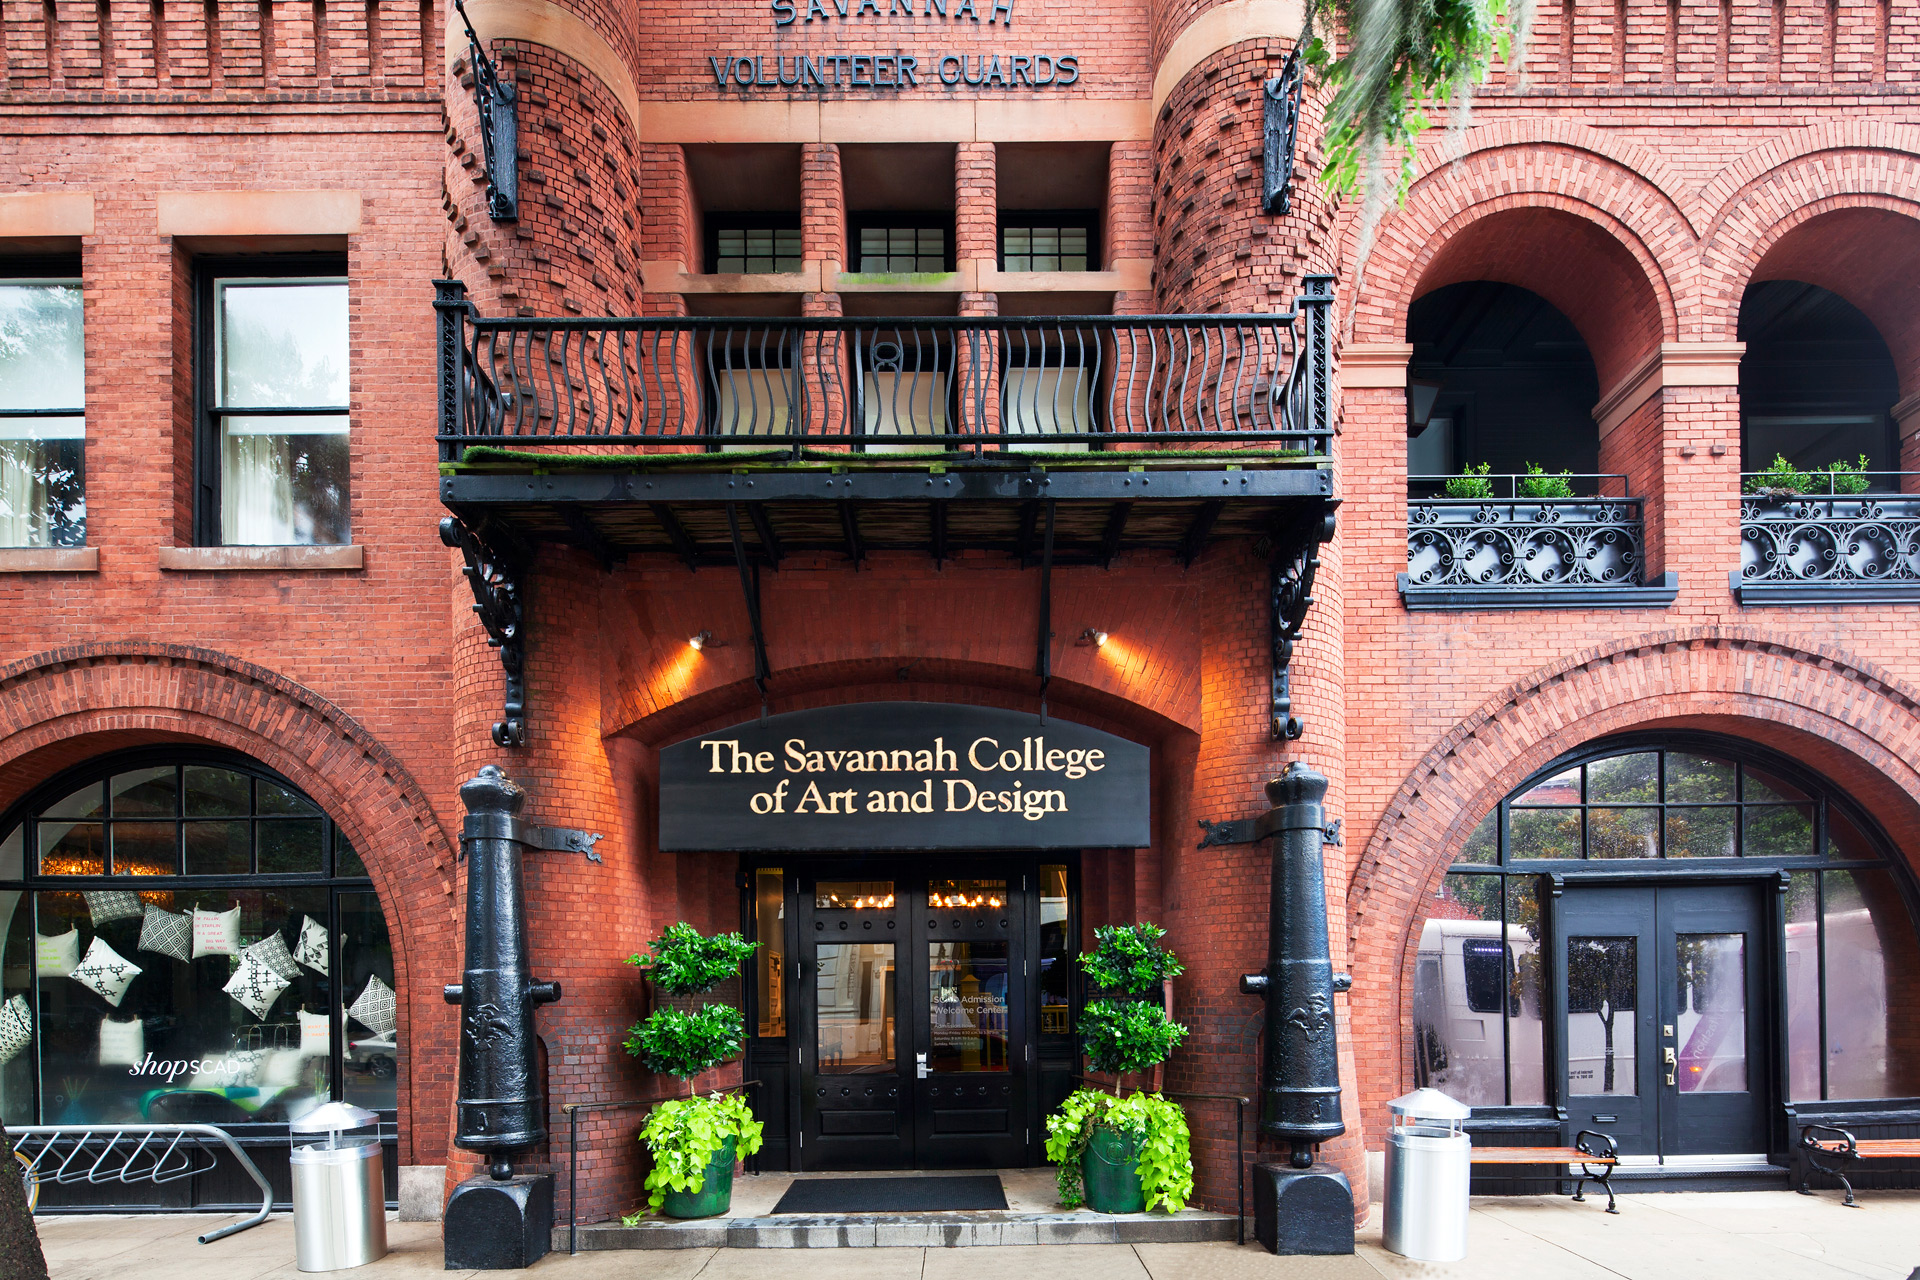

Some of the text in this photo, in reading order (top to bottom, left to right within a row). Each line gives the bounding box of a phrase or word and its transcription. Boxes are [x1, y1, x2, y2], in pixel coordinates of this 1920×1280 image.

[709, 55, 1080, 86] VOLUNTEER GUARDS
[701, 736, 1106, 779] The Savannah College
[750, 779, 1068, 821] of Art and Design
[934, 1006, 1004, 1014] Welcome Center
[961, 995, 1005, 1003] Admission
